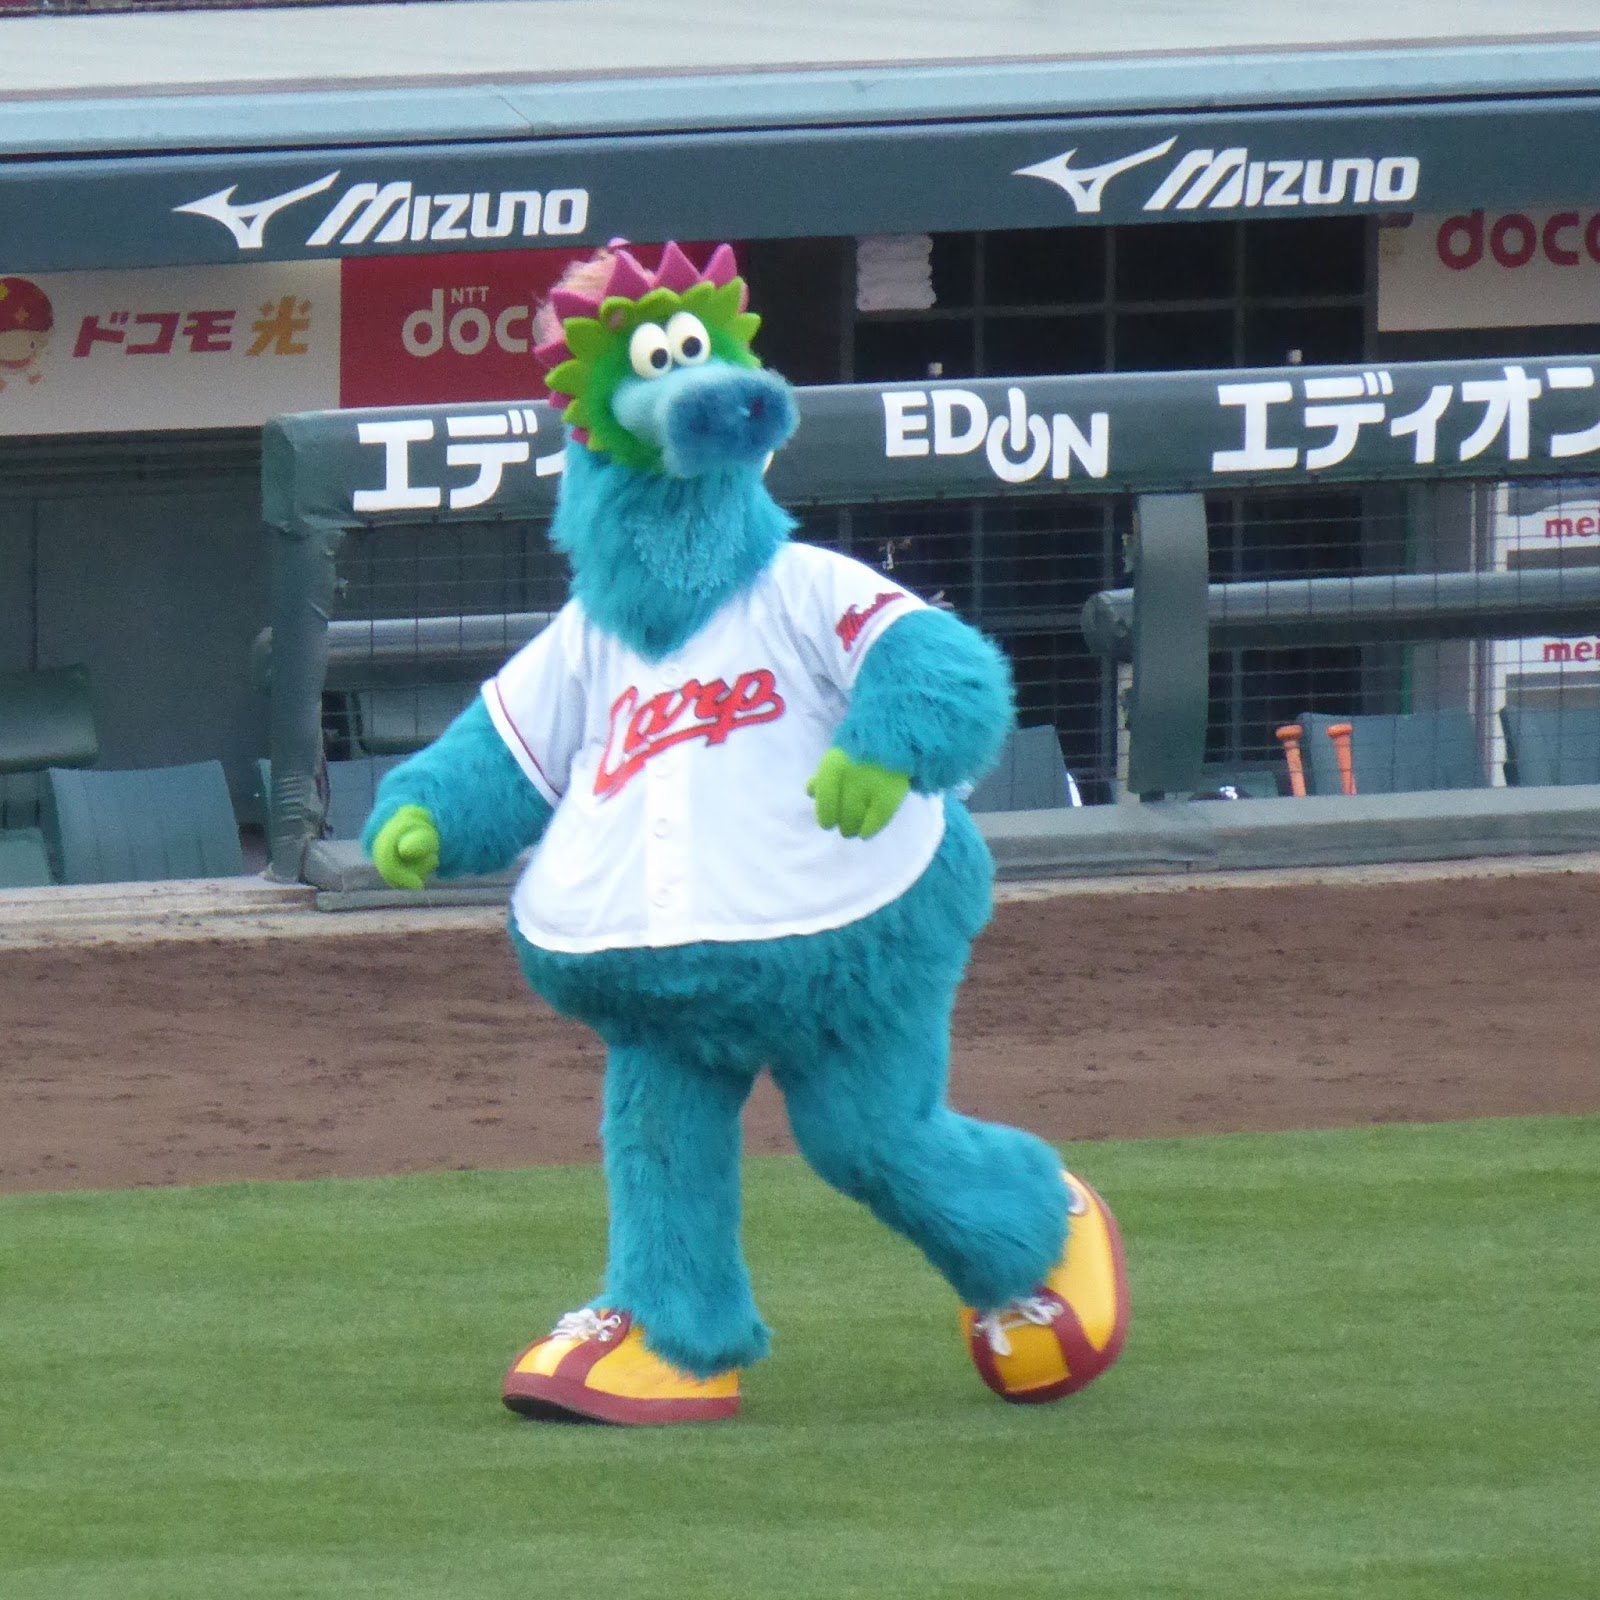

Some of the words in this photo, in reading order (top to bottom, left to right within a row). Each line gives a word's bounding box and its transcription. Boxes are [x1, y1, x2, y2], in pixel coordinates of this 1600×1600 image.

[1142, 148, 1420, 211] MIZUNO
[305, 181, 589, 246] MIZUNO
[451, 286, 489, 303] NTT
[882, 387, 1109, 483] EDION
[593, 669, 786, 801] Carp
